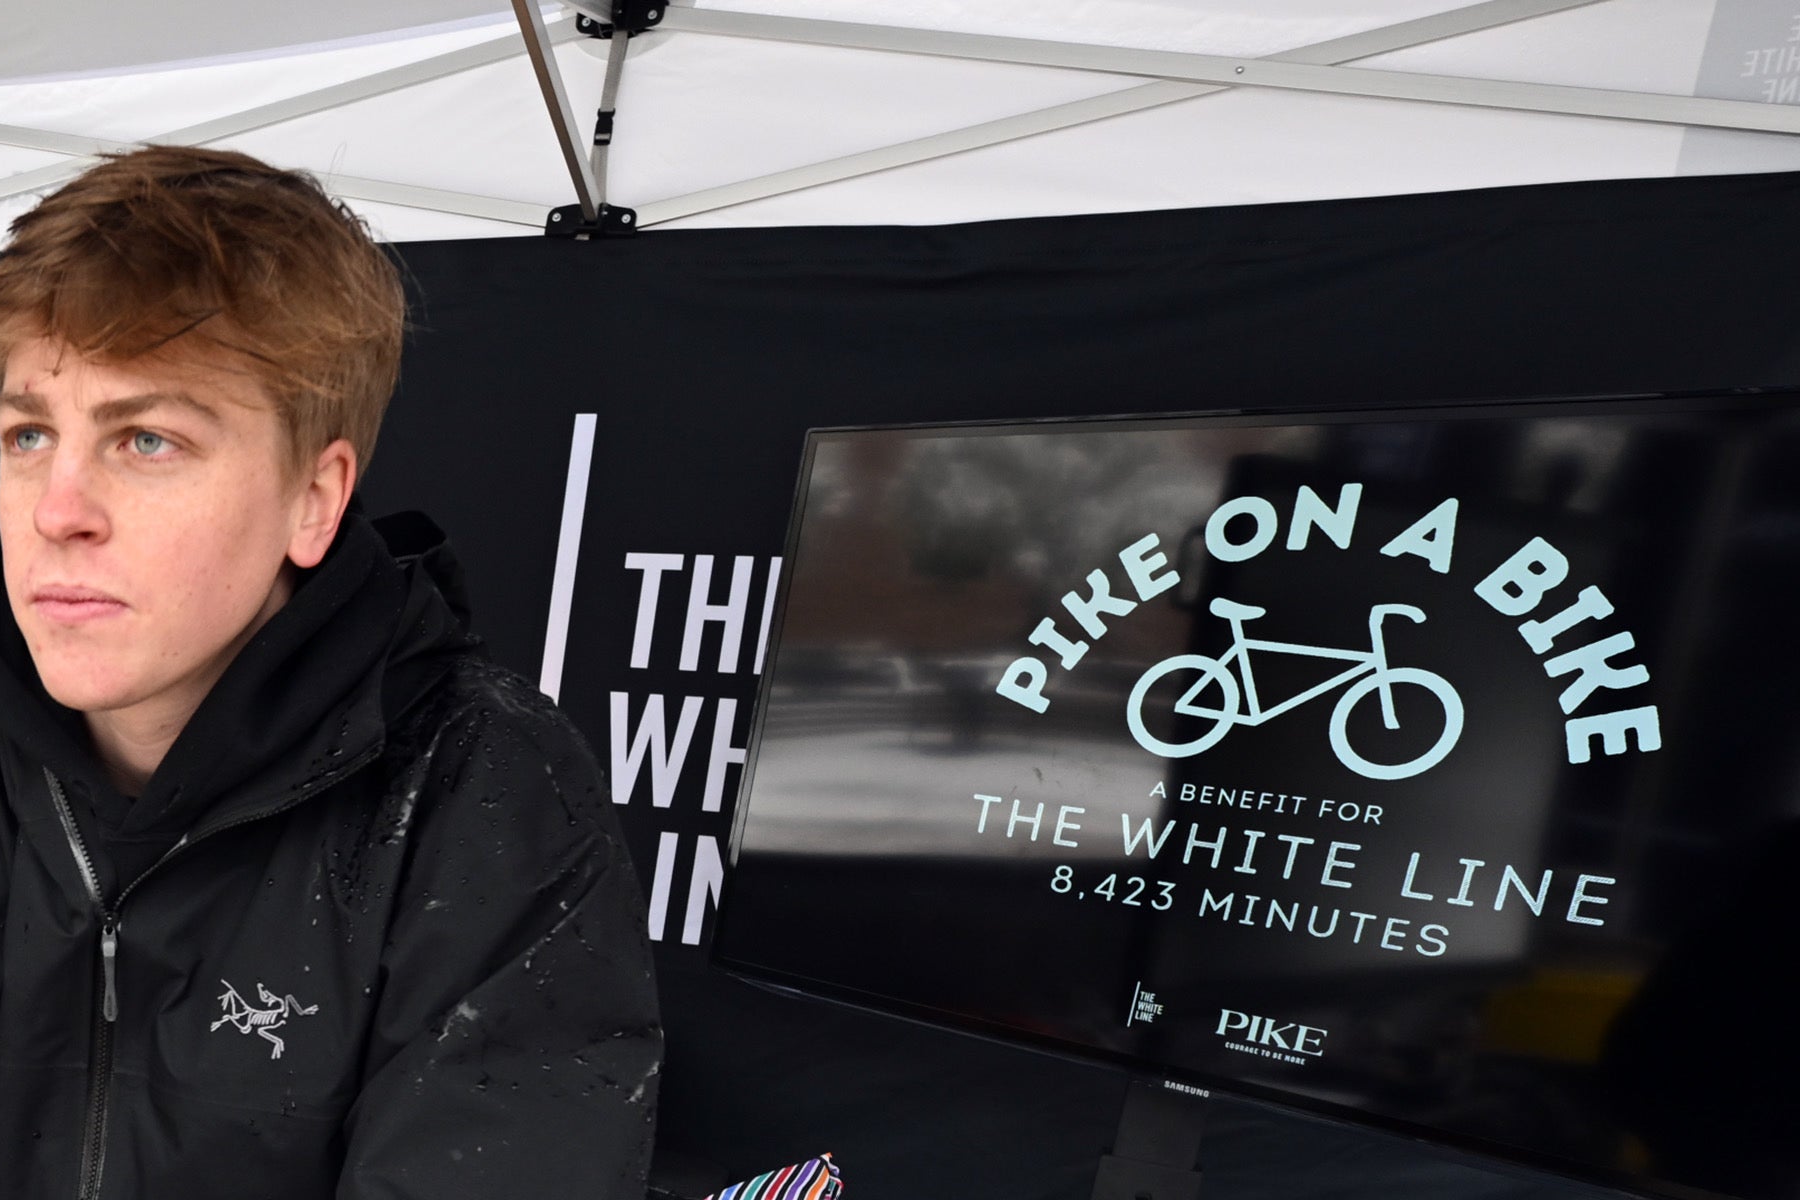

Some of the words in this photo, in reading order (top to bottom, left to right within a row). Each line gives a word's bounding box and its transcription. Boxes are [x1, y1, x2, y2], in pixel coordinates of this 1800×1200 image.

[994, 533, 1180, 713] PIKE
[1205, 483, 1362, 562] ON
[1380, 498, 1458, 573] A
[1474, 537, 1661, 764] BIKE
[1150, 782, 1167, 799] A
[1180, 784, 1307, 815] BENEFIT
[1319, 800, 1384, 825] FOR
[974, 795, 1085, 848] THE
[1122, 814, 1362, 889] WHITE
[1401, 852, 1616, 926] LINE
[1050, 866, 1176, 911] 8,423
[1199, 889, 1449, 957] MINUTES
[1137, 1001, 1164, 1016] WHITE
[1140, 991, 1156, 1003] THE
[1134, 1010, 1154, 1023] LINE
[1215, 1008, 1328, 1057] PIKE
[1224, 1041, 1259, 1056] COURAGE
[1261, 1049, 1270, 1057] TO
[1284, 1054, 1306, 1066] MORE
[1163, 1079, 1210, 1098] SAMSUNG
